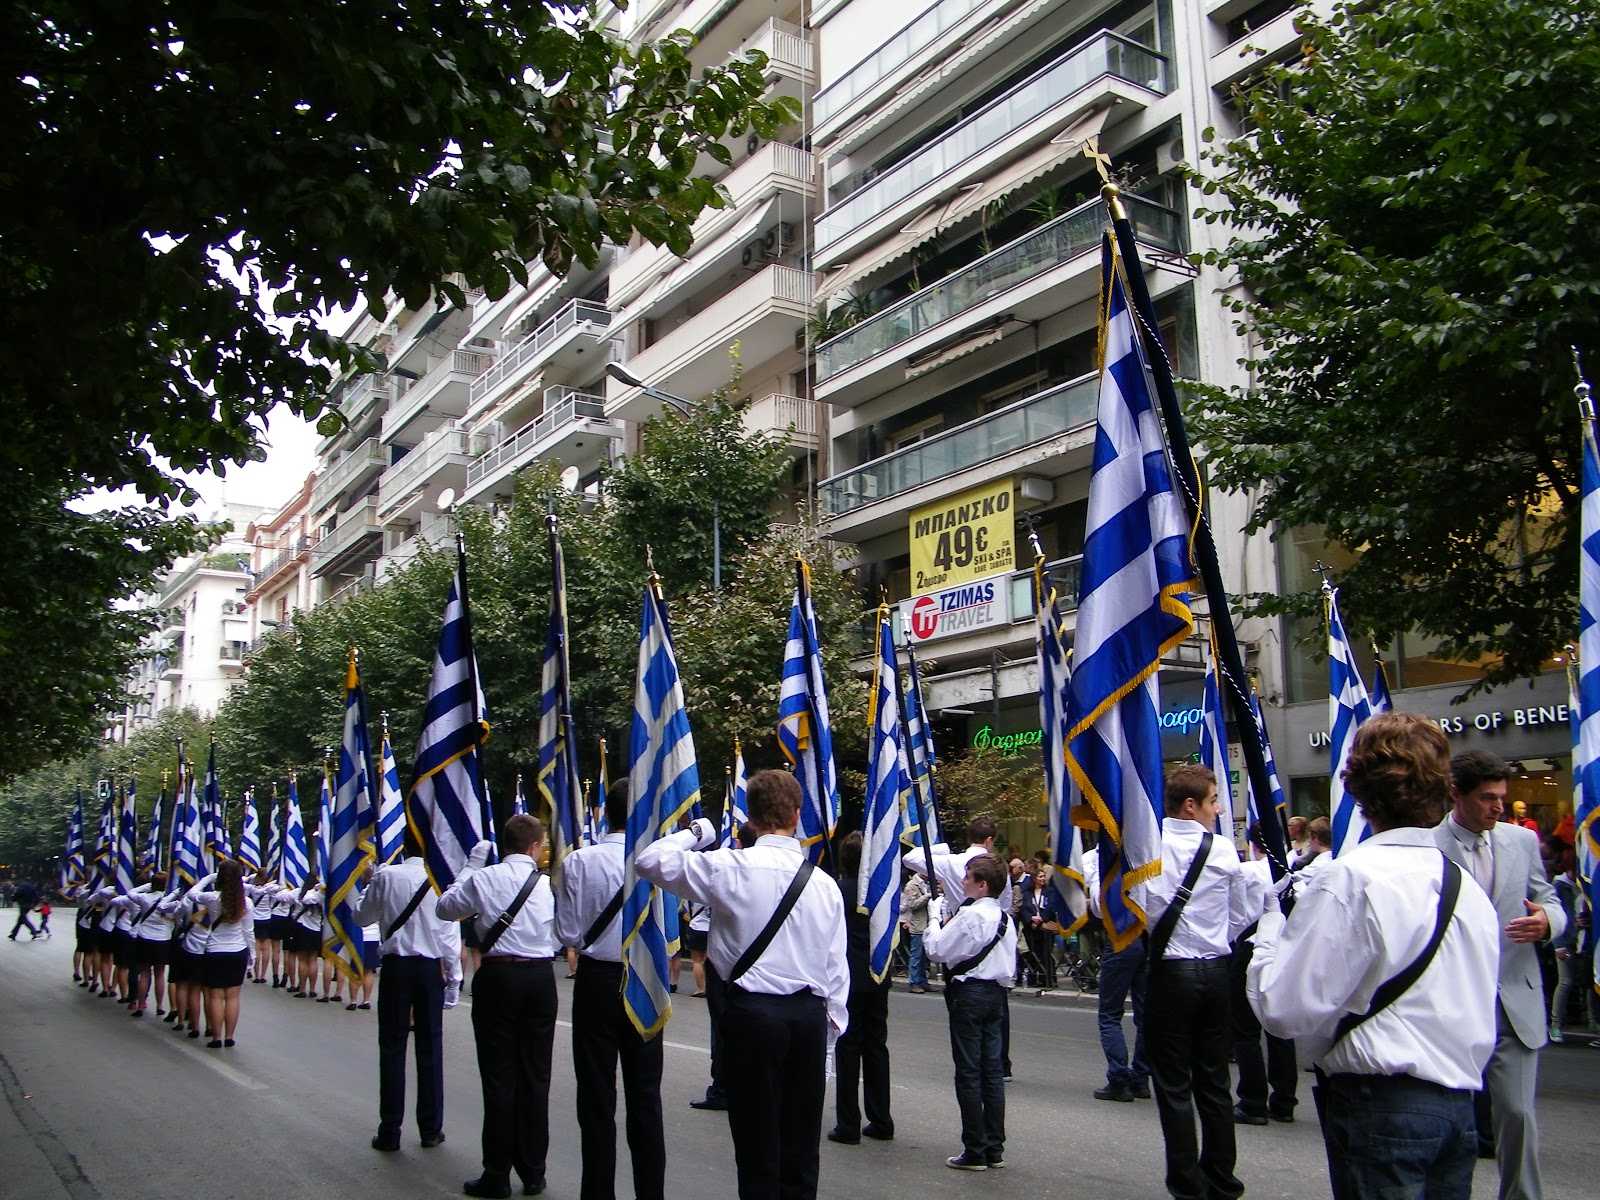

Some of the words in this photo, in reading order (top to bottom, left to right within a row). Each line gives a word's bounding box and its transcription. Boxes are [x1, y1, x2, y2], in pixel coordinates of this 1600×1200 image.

[914, 491, 1010, 539] ΜΠΑΝΣΚΟ
[973, 553, 987, 566] SKI
[995, 546, 1012, 560] SPA
[940, 582, 994, 612] TZIMAS
[939, 603, 994, 633] TRAVEL
[1474, 711, 1502, 730] OF
